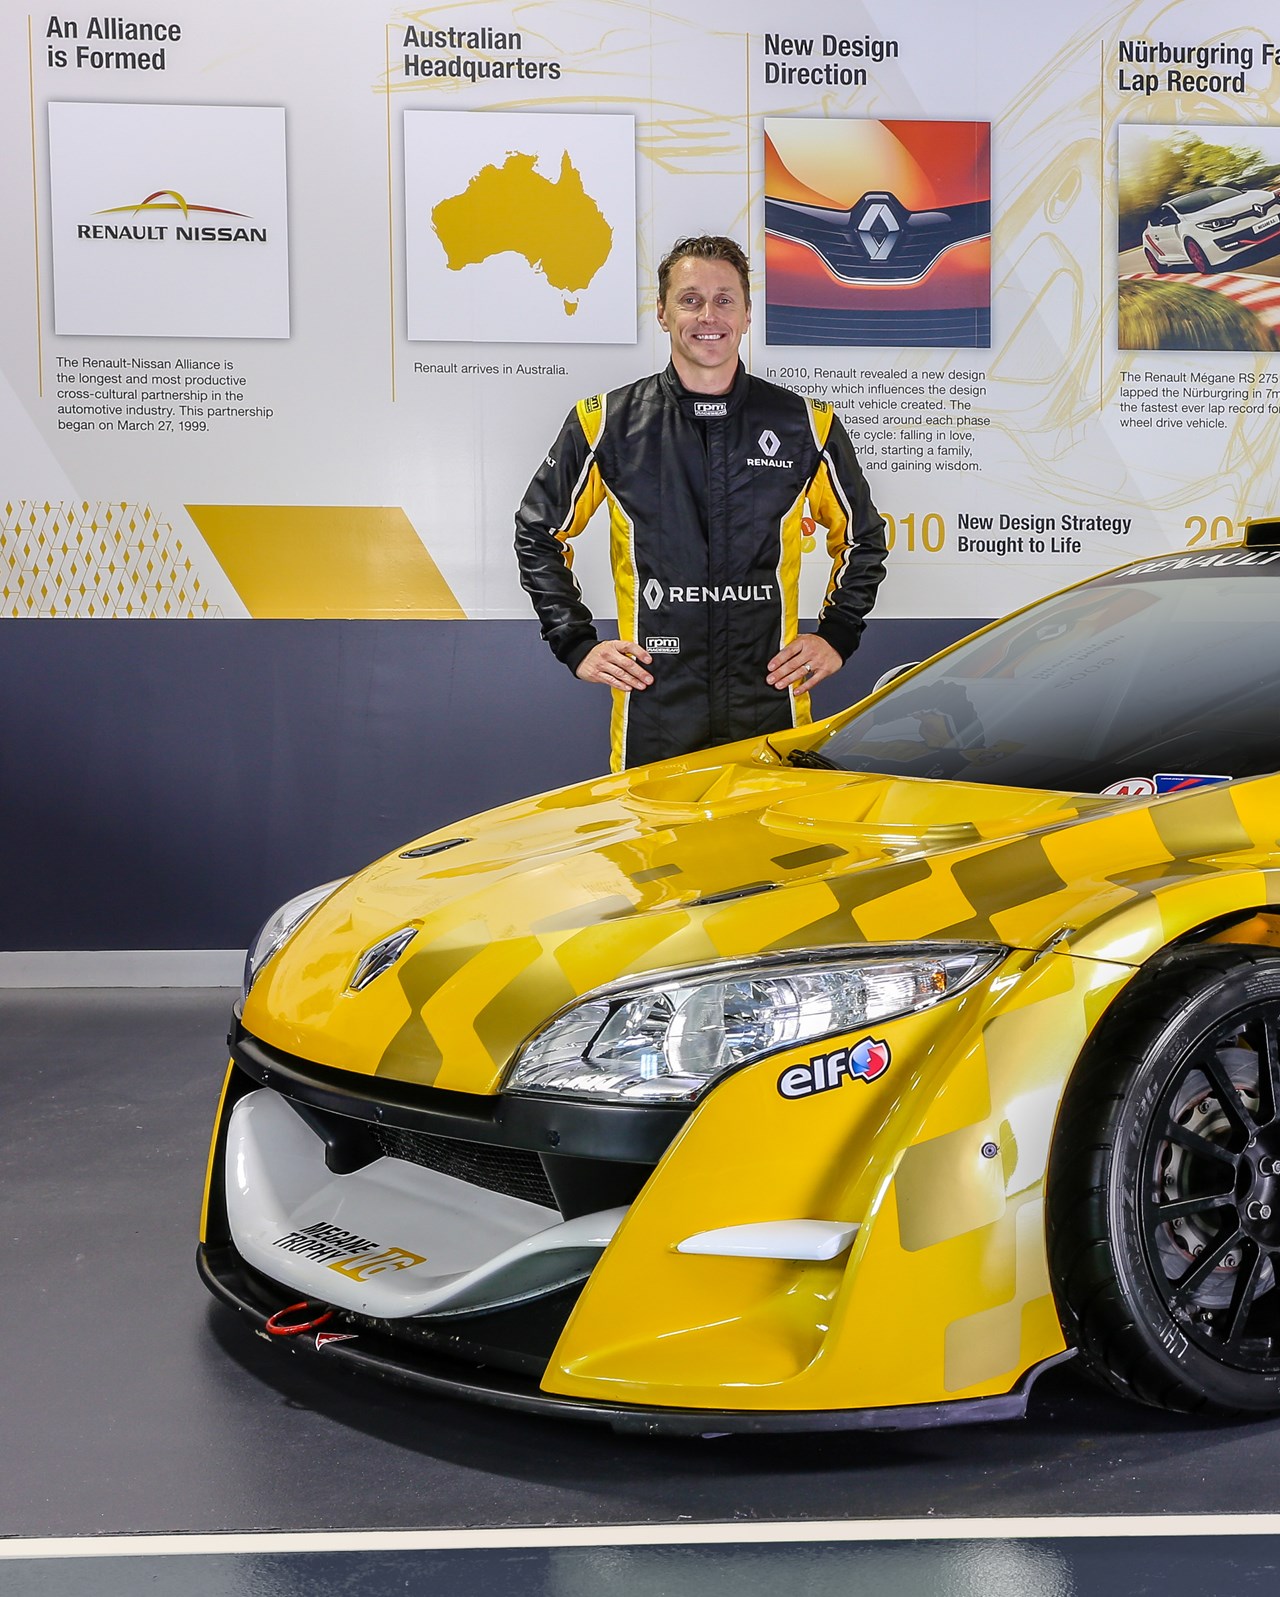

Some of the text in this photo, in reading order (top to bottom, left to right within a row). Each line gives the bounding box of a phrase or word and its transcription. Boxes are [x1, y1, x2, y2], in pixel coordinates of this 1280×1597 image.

[45, 15, 182, 42] An Alliance
[402, 24, 522, 51] Australian
[764, 33, 899, 63] New Design
[1118, 40, 1254, 71] Nürburgring
[47, 44, 166, 71] is Formed
[404, 53, 562, 84] Headquarters
[764, 61, 867, 86] Direction
[1118, 68, 1246, 97] Lap Record
[76, 224, 267, 243] RENAULT NISSAN
[55, 356, 234, 371] The Renault-Nissan Alliance is
[413, 361, 569, 376] Renault arrives in Australia.
[55, 372, 247, 388] the longest and most productive
[766, 366, 986, 382] In 2010, Renault revealed a new design
[1119, 370, 1142, 383] The
[1144, 371, 1188, 383] Renault
[1189, 371, 1236, 386] Mégane
[1238, 372, 1256, 384] RS
[1257, 372, 1280, 385] 275
[56, 388, 244, 404] cross-cultural partnership in the
[832, 383, 865, 394] which
[867, 383, 926, 395] influences
[927, 384, 947, 395] the
[948, 385, 988, 398] design
[1119, 386, 1159, 400] lapped
[1161, 386, 1180, 399] the
[1182, 387, 1250, 402] Nürburgring
[1251, 387, 1263, 399] in
[56, 403, 274, 420] automotive industry. This partnership
[696, 403, 724, 412] rpm
[857, 398, 898, 410] vehicle
[900, 399, 947, 411] created.
[949, 399, 972, 411] The
[1119, 401, 1138, 413] the
[1140, 401, 1179, 414] fastest
[1180, 404, 1206, 414] ever
[1207, 402, 1226, 416] lap
[1228, 403, 1265, 415] record
[57, 418, 210, 433] began on March 27, 1999.
[843, 413, 991, 428] based around each phase
[1119, 416, 1228, 429] wheel drive vehicle.
[863, 429, 897, 443] cycle:
[899, 429, 933, 443] falling
[936, 429, 947, 441] in
[949, 429, 975, 442] love,
[854, 444, 973, 459] orld, starting a family,
[747, 457, 794, 469] RENAULT
[865, 459, 983, 472] and gaining wisdom.
[957, 513, 1132, 536] New Design Strategy
[957, 535, 1082, 557] Brought to Life
[669, 584, 774, 603] RENAULT
[648, 638, 678, 648] rpm
[780, 1051, 847, 1098] elf
[299, 1221, 380, 1255] MEGANE
[272, 1231, 347, 1264] TROPHY
[330, 1248, 424, 1282] V6
